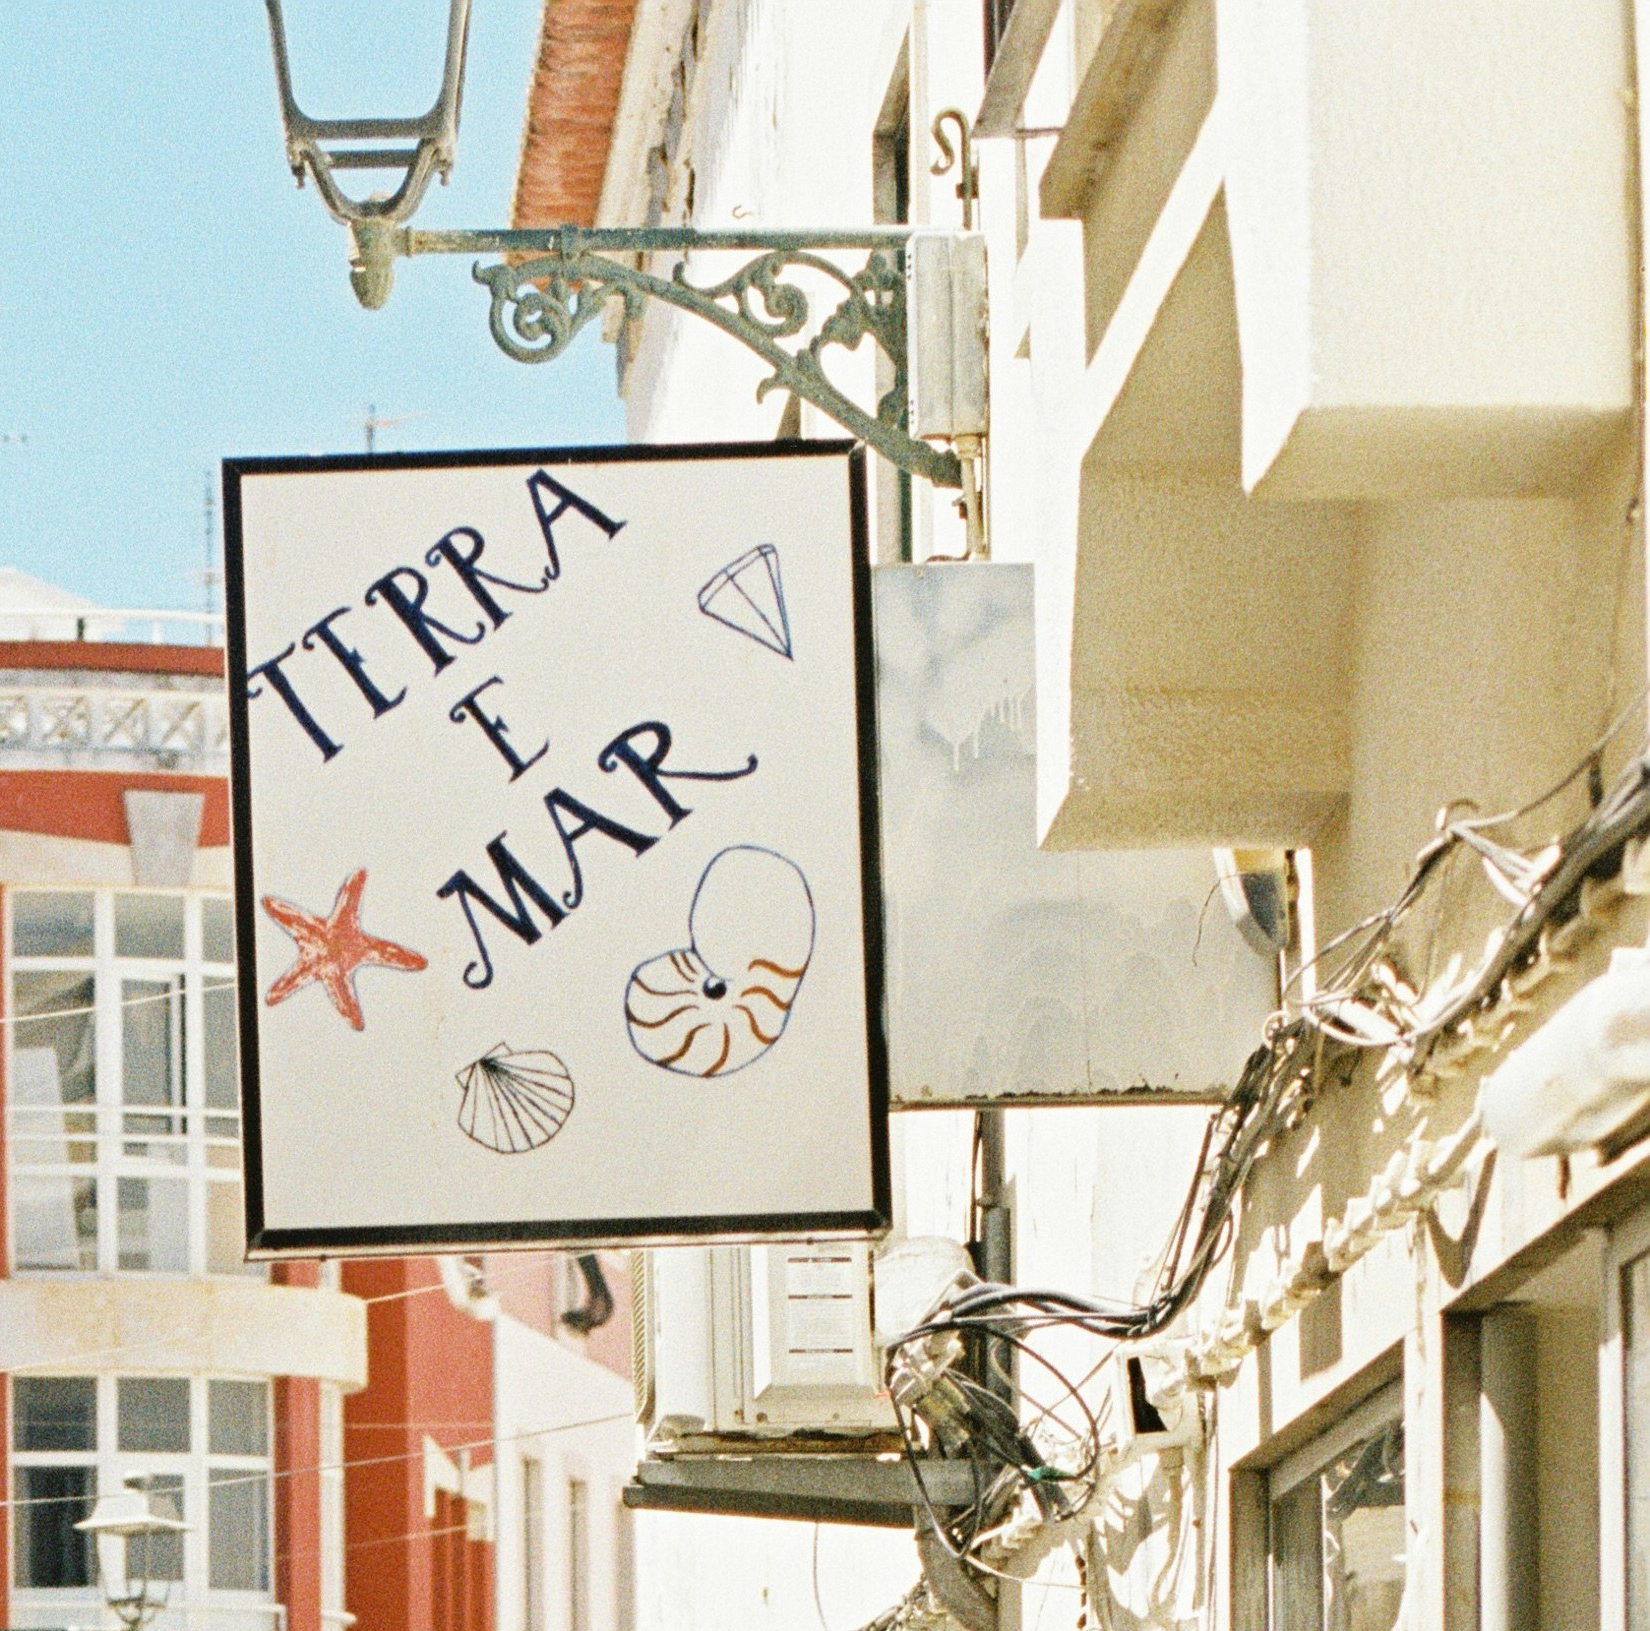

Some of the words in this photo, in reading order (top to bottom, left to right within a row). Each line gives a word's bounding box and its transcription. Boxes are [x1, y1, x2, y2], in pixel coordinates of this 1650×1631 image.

[245, 469, 627, 763] TERRA
[449, 676, 549, 782] E
[437, 720, 758, 988] MAR
